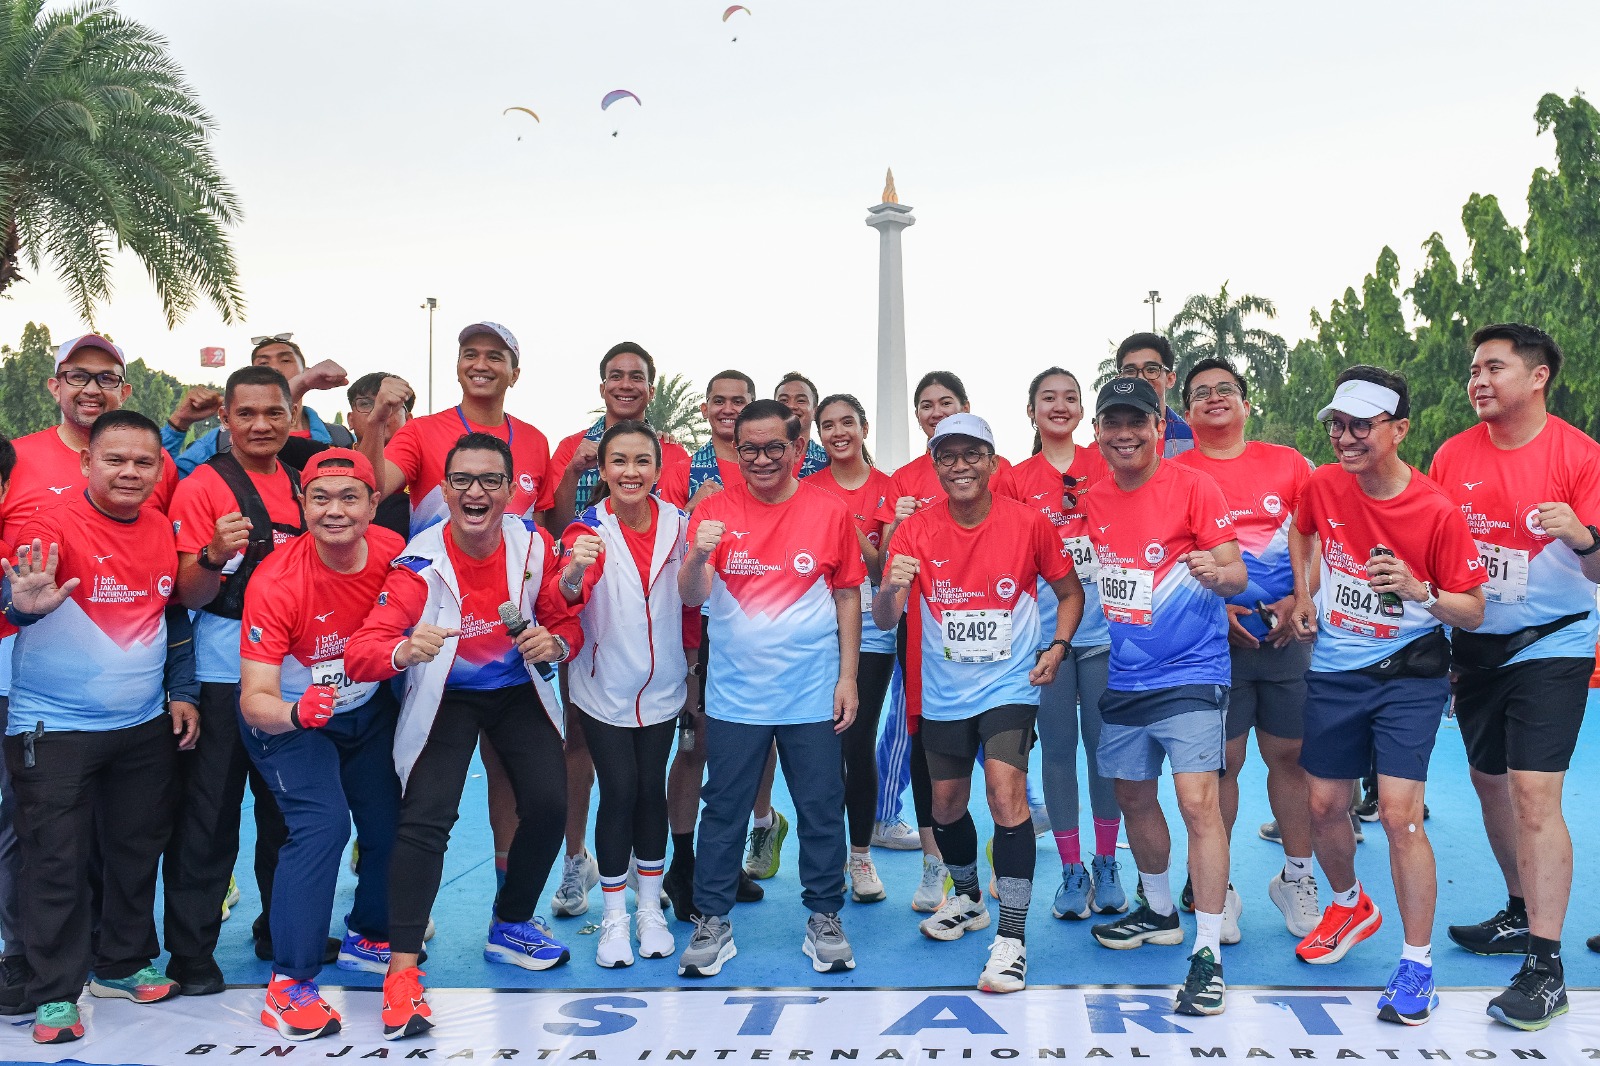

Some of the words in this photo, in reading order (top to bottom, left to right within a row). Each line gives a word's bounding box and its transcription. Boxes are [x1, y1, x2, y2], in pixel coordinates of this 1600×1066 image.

[1461, 502, 1472, 513] tn
[1215, 514, 1231, 529] bt
[731, 563, 781, 571] INTERNATIONAL
[1467, 556, 1485, 570] bt
[1101, 577, 1137, 600] 15687
[461, 619, 485, 628] AKARTA
[948, 621, 997, 641] 62492
[543, 995, 1352, 1036] START
[185, 1043, 298, 1058] BTN
[325, 1044, 602, 1060] JAKARTA
[637, 1047, 1151, 1060] INTERNATIONAL
[1189, 1047, 1548, 1060] MARATHON
